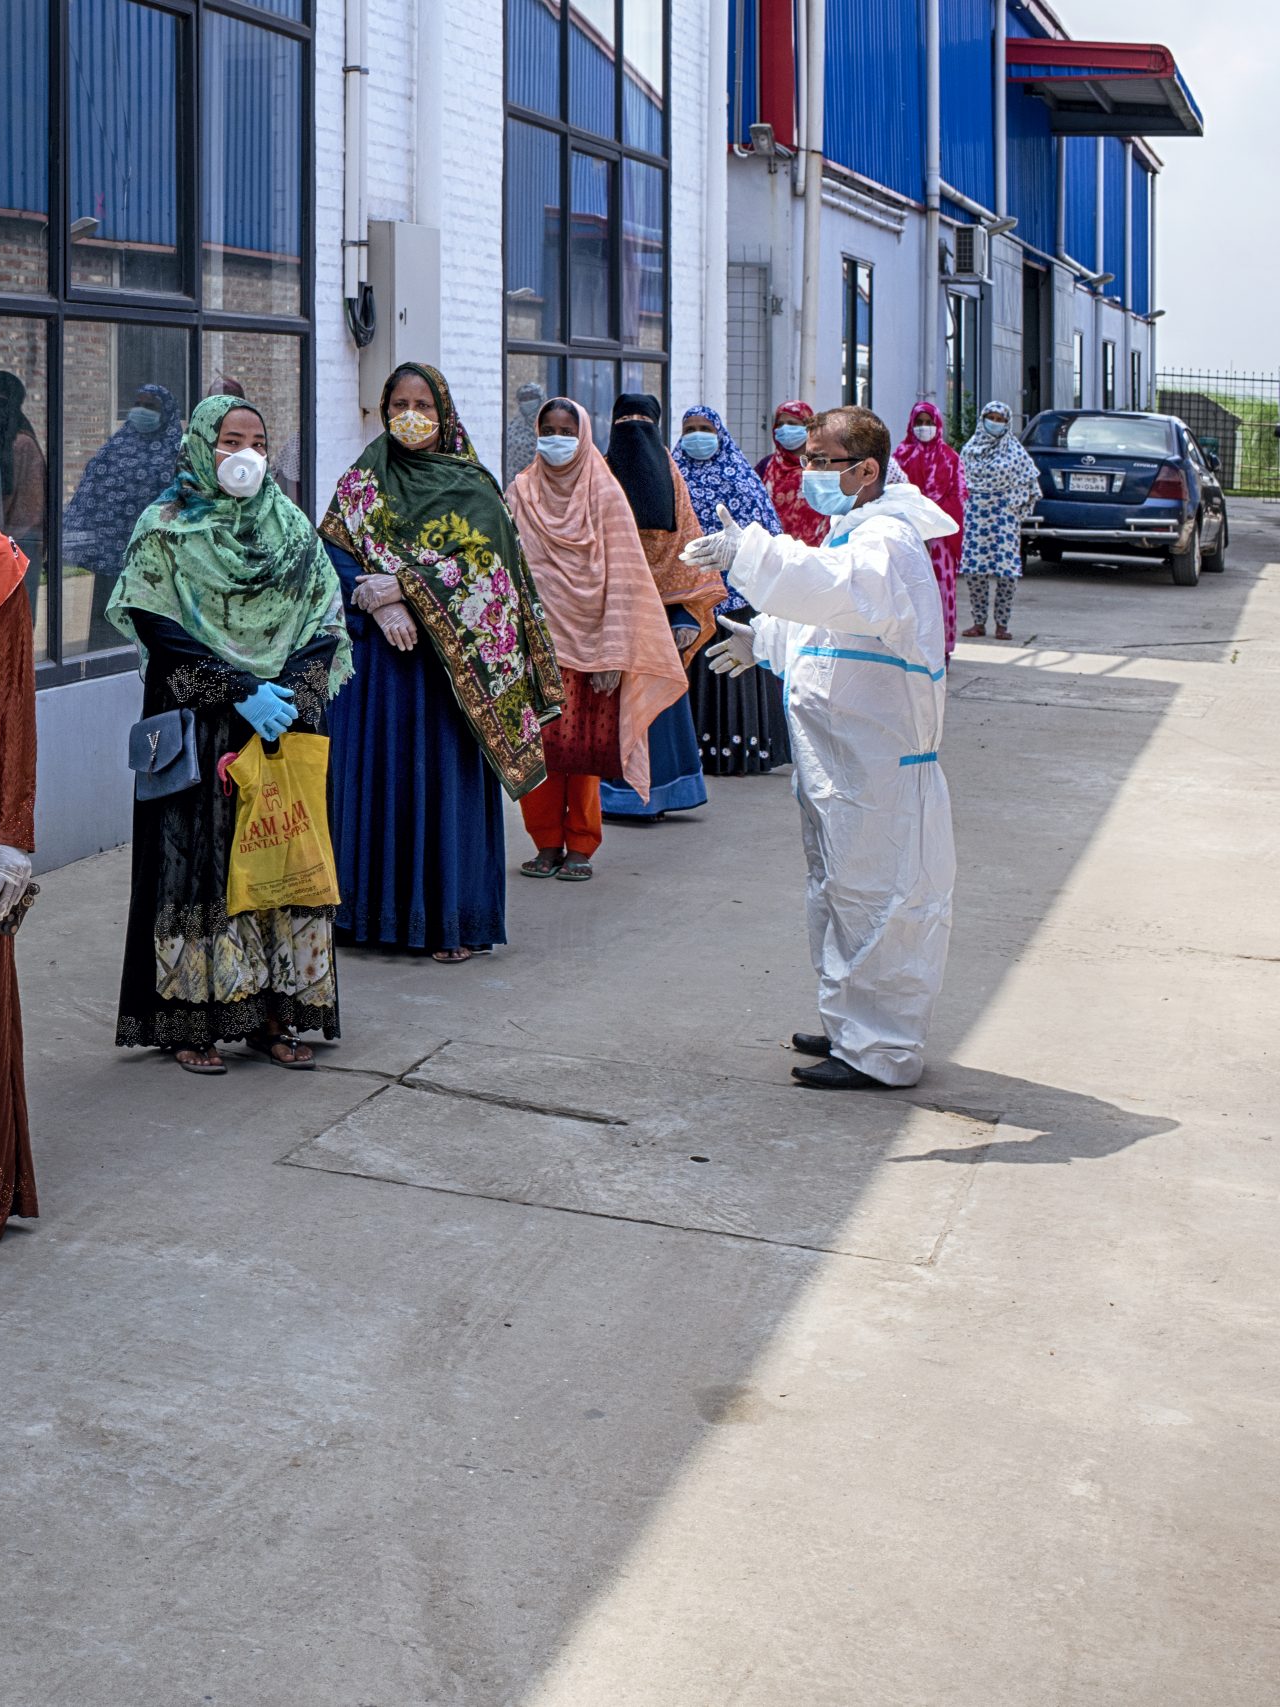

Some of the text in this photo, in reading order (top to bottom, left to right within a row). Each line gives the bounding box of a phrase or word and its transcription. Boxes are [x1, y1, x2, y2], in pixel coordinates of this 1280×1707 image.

[282, 800, 310, 832] JM
[240, 820, 311, 854] DENTAL SPPLY
